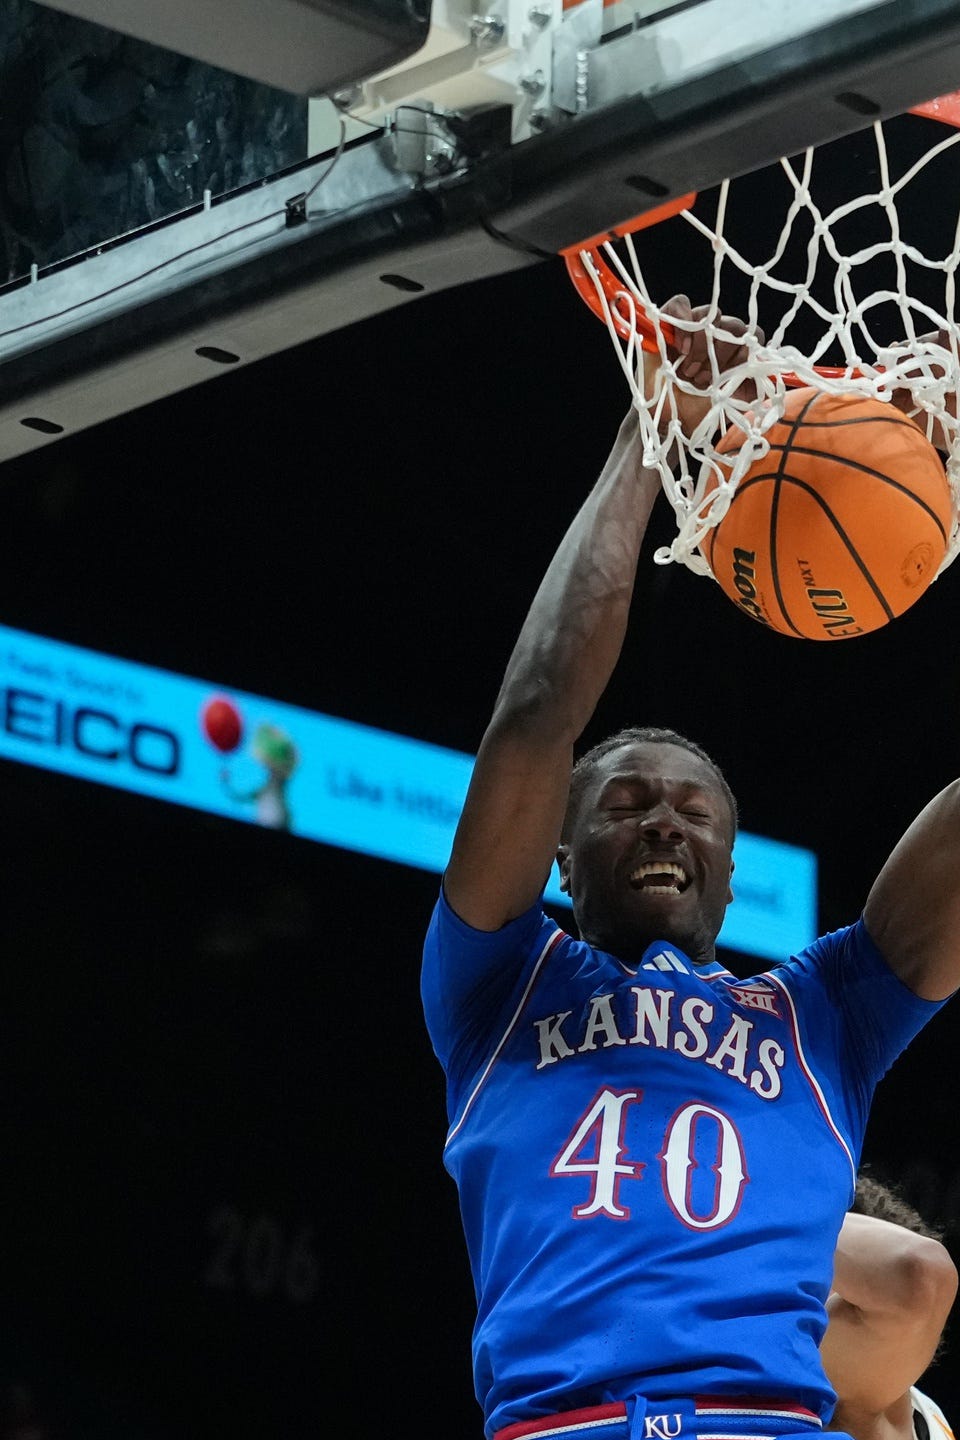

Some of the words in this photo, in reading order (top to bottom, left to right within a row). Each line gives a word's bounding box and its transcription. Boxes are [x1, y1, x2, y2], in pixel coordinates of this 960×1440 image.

[796, 558, 817, 587] NXT
[806, 587, 863, 638] EVO
[532, 986, 786, 1100] KANSAS
[549, 1084, 750, 1232] 40
[643, 1413, 683, 1440] KU
